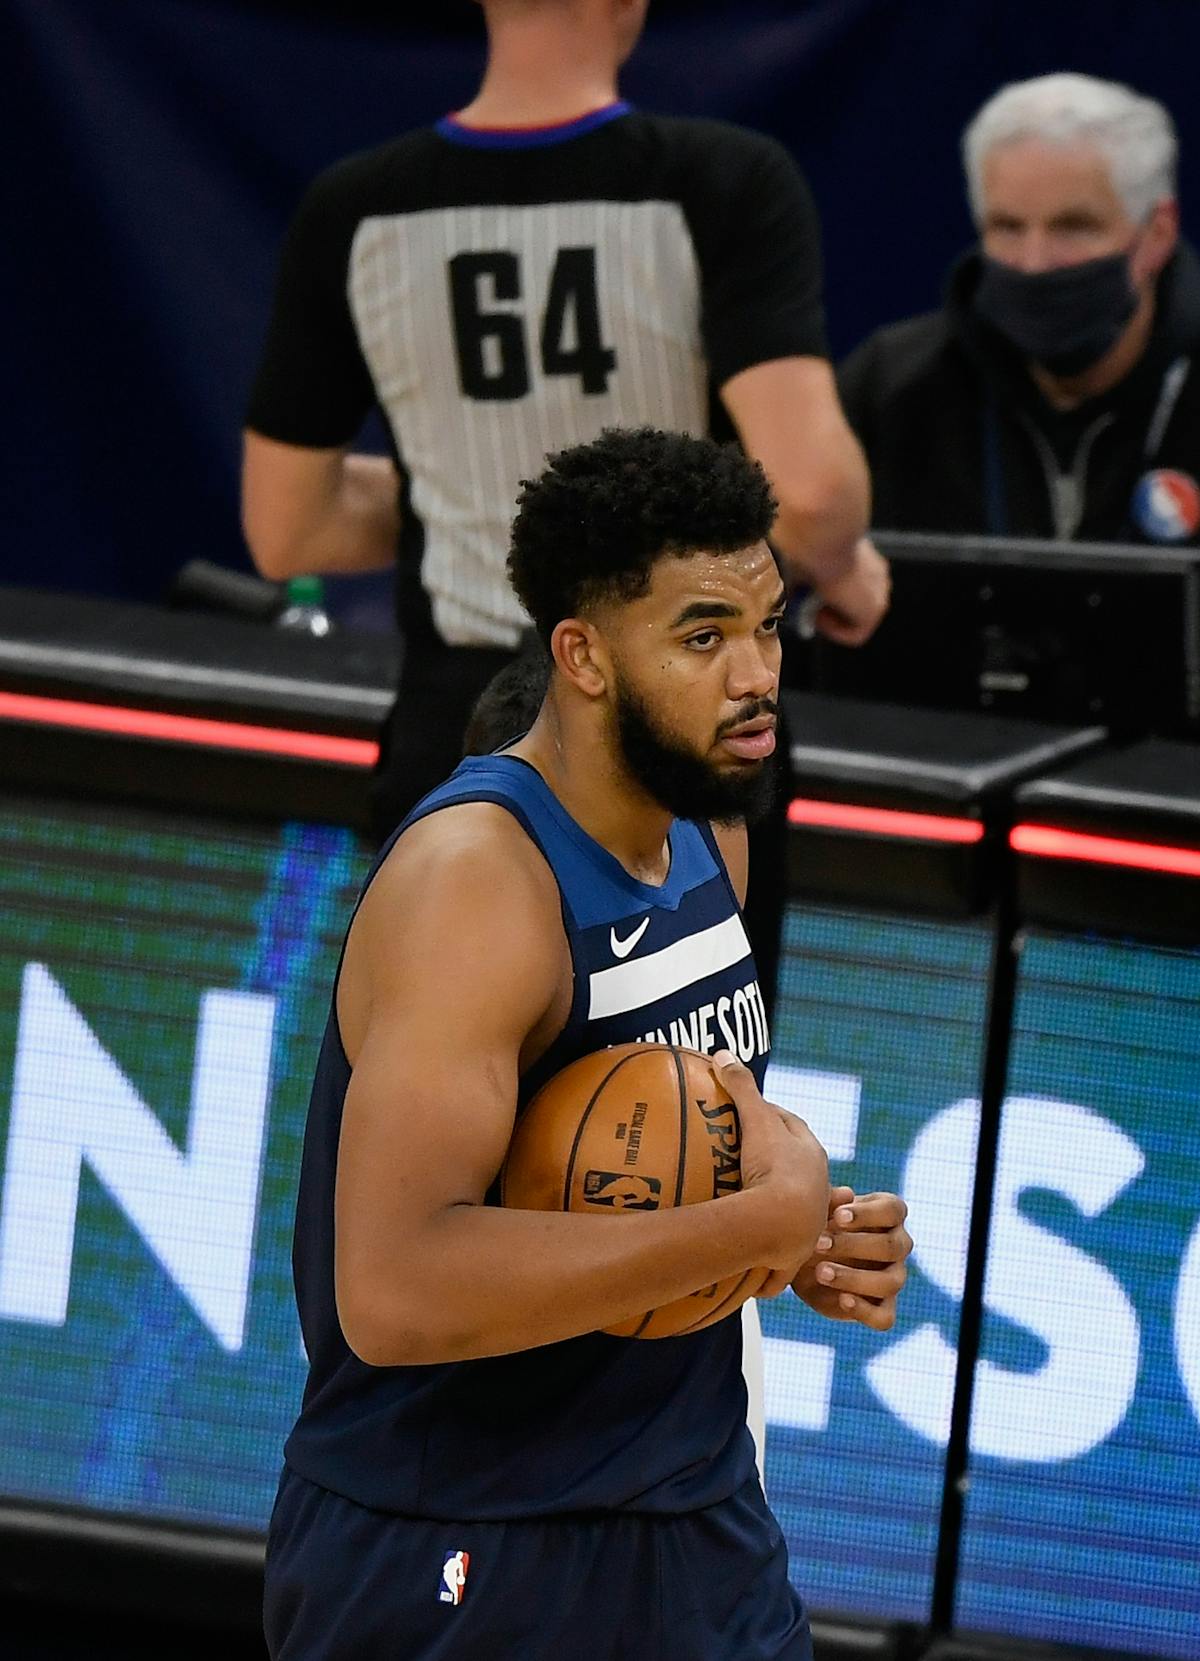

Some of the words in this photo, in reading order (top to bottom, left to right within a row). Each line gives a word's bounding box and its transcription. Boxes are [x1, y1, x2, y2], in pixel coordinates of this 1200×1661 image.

[448, 248, 617, 401] 64
[631, 1102, 649, 1129] OFFICIAL
[627, 1129, 642, 1149] GAME
[624, 1149, 639, 1166] BALL
